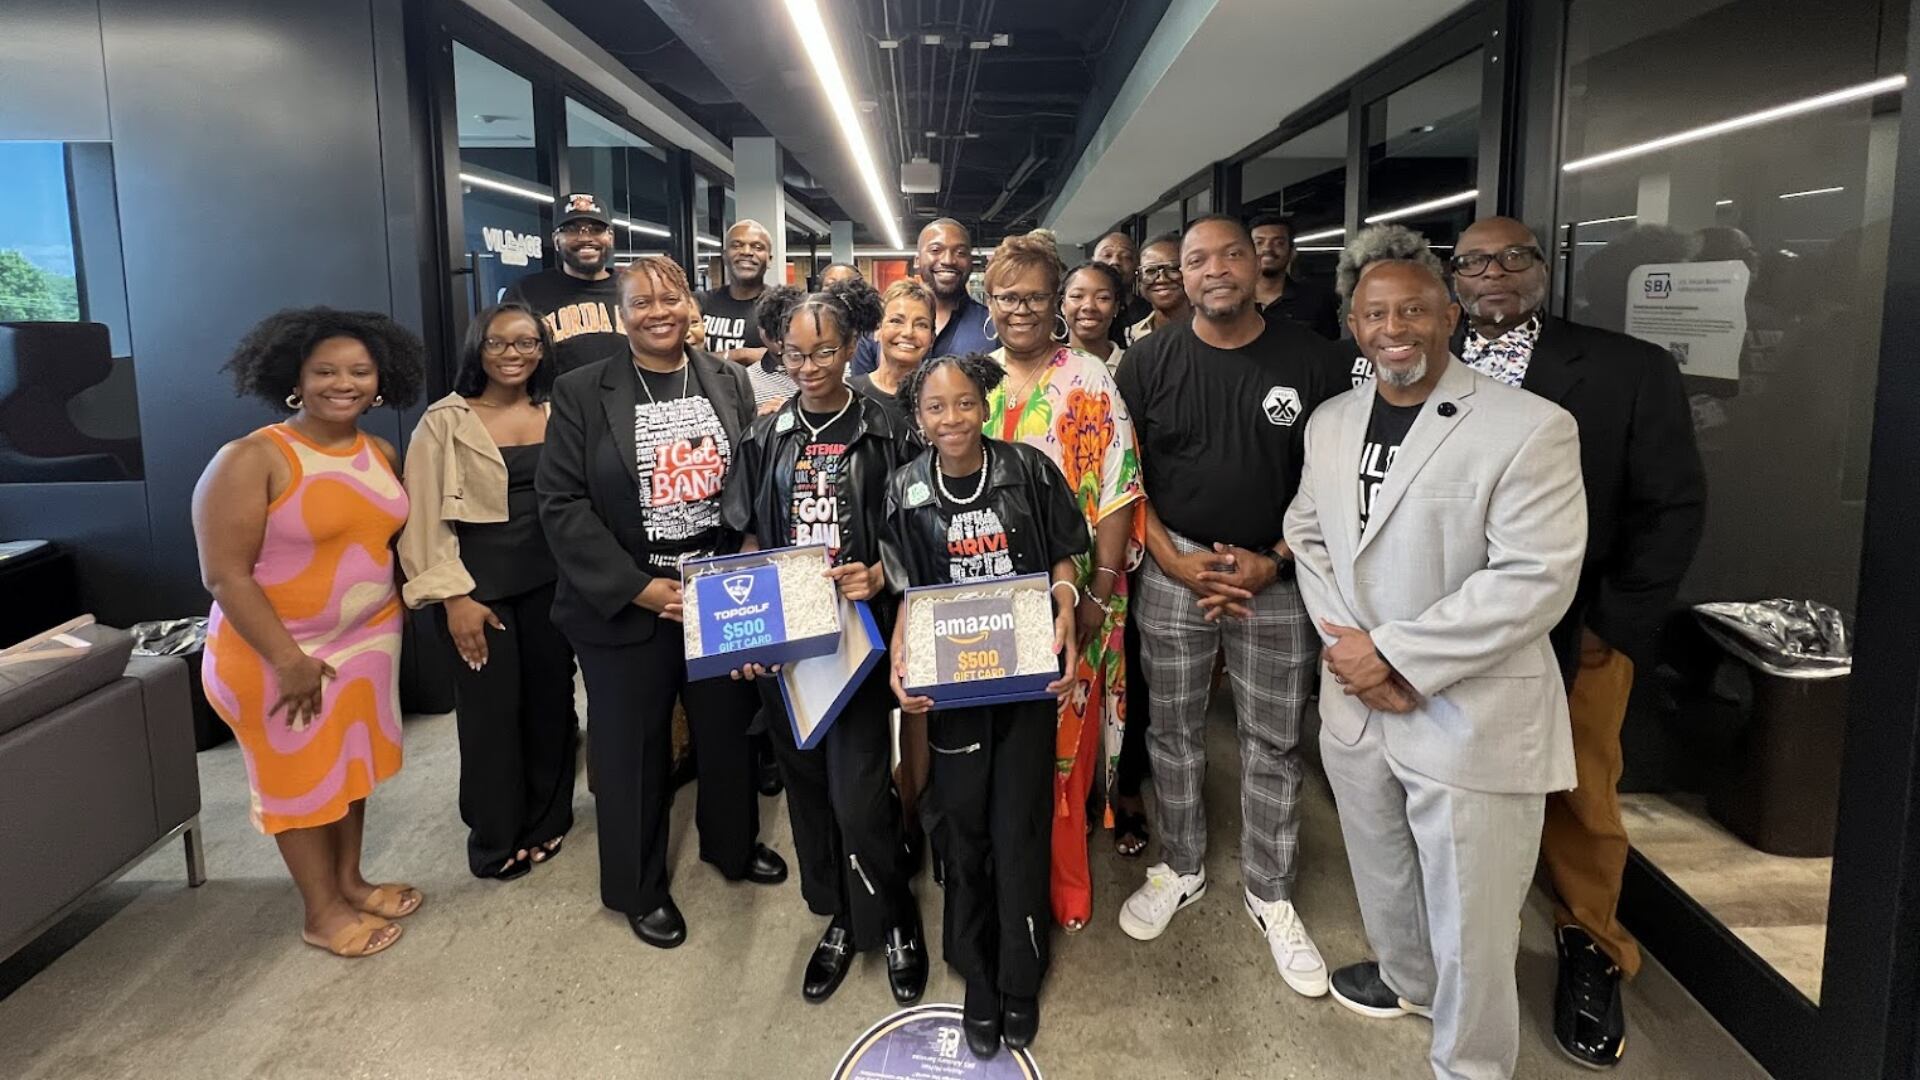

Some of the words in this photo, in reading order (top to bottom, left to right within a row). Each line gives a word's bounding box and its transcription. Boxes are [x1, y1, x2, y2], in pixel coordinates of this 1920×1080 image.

[1644, 279, 1672, 293] SBA
[713, 602, 770, 621] TOPGOLF
[722, 617, 766, 641] $500
[934, 612, 1015, 637] amazon
[718, 640, 744, 654] GIFT
[743, 633, 772, 649] CARD
[957, 648, 1000, 671] $500
[953, 670, 977, 683] GIFT
[976, 667, 1006, 680] CARD
